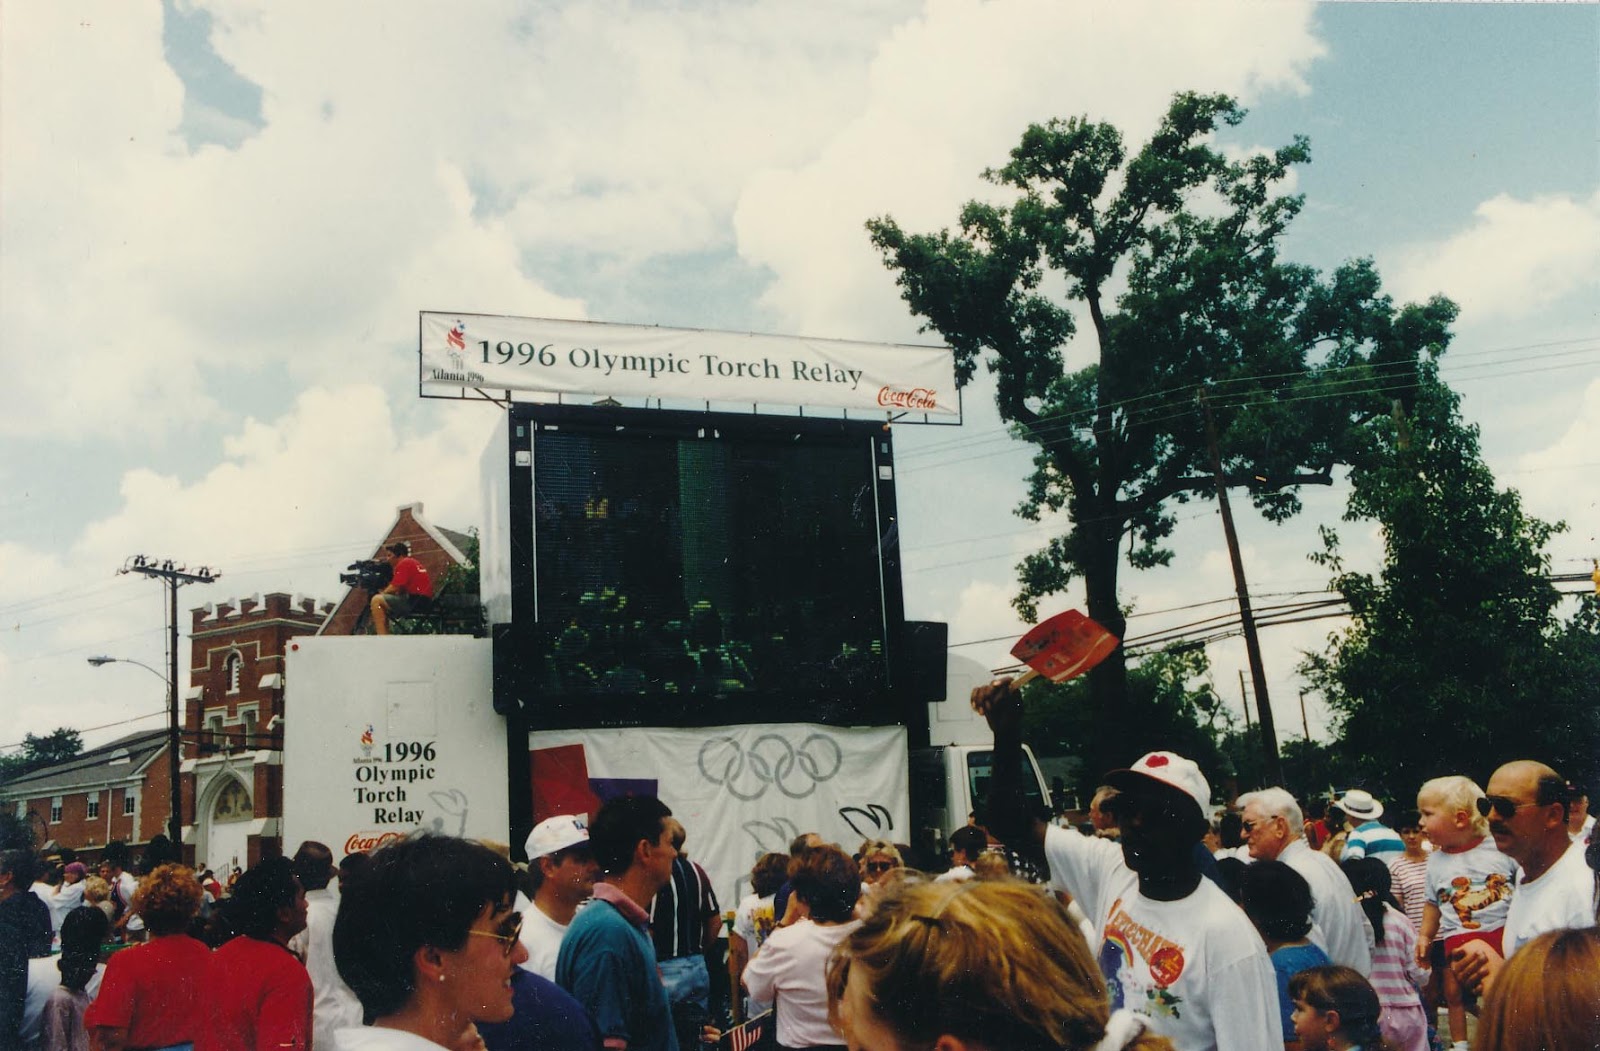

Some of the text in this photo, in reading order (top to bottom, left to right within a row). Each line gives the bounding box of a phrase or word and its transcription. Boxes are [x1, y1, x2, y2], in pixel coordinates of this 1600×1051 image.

[478, 340, 863, 390] 1996 Olympic Torch Relay
[385, 741, 436, 763] 1996
[355, 764, 435, 784] Olympic
[353, 786, 406, 804] Torch
[375, 807, 424, 826] Relay
